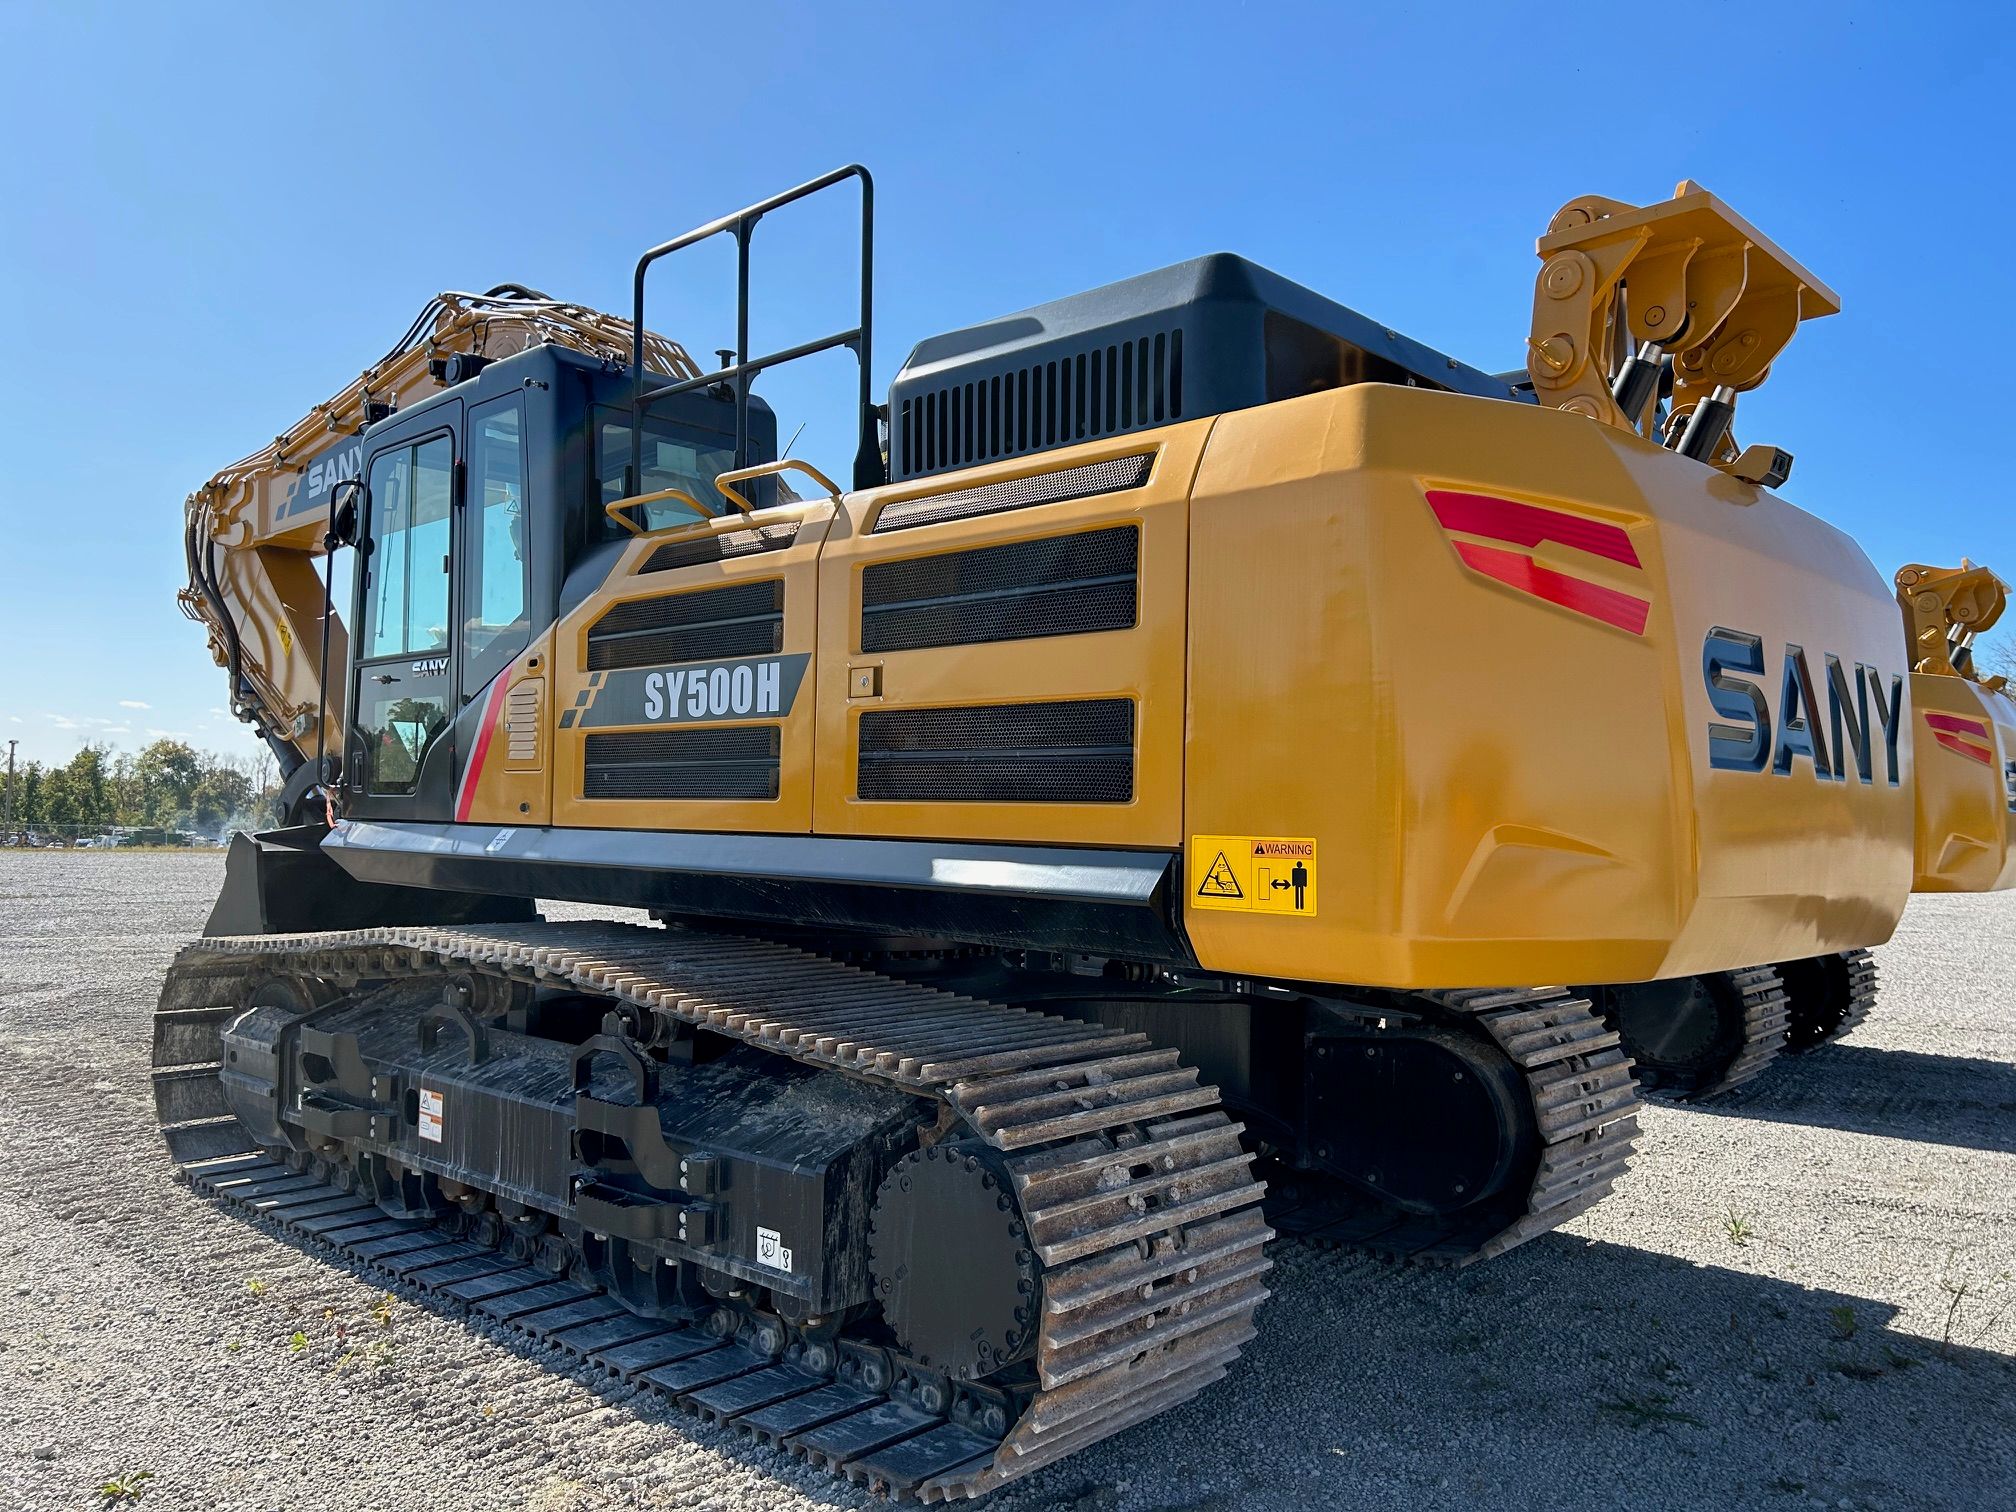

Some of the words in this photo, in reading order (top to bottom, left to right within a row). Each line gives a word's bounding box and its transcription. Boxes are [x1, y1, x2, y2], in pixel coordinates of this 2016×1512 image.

[412, 658, 449, 678] SANY
[644, 662, 780, 720] SY500H
[1702, 625, 1903, 788] SANY
[1265, 843, 1312, 856] WARNING
